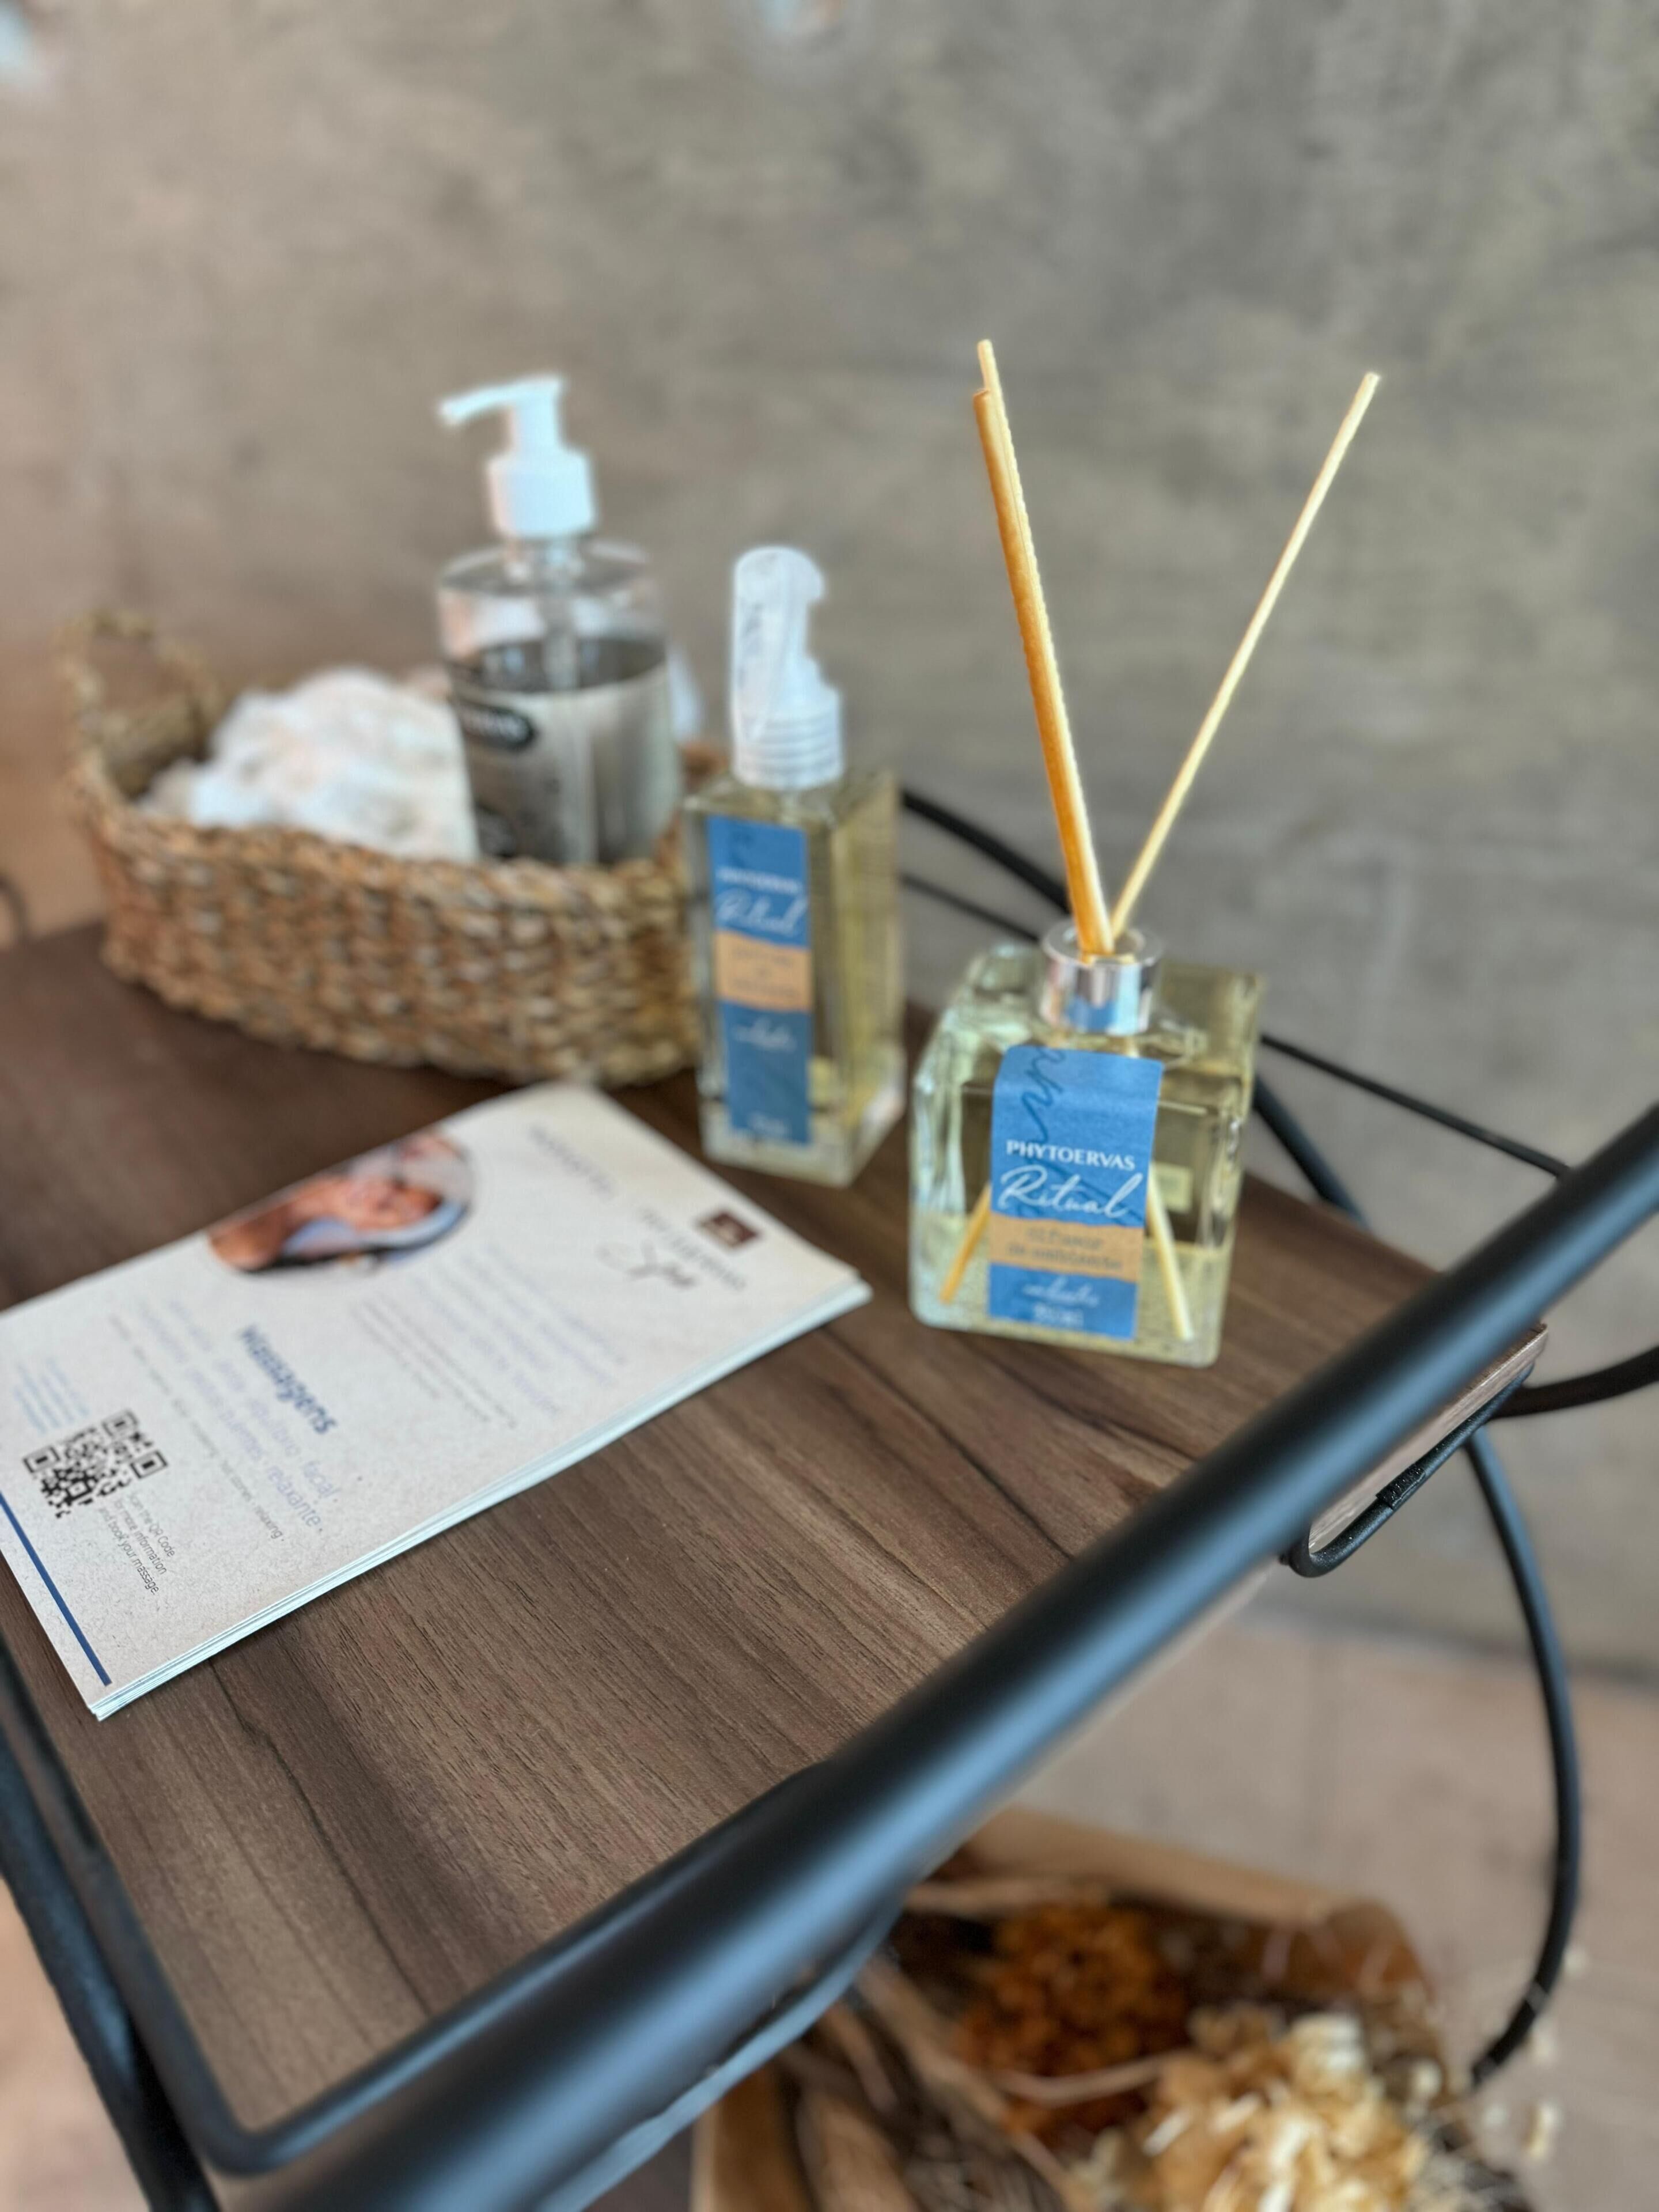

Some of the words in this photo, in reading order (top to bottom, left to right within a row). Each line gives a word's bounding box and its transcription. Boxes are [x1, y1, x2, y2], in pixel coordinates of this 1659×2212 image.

[1006, 1139, 1136, 1171] PHYTOERVAS
[997, 1164, 1144, 1218] Ritual
[266, 1464, 320, 1527] relaxante
[108, 1520, 126, 1540] book
[118, 1540, 137, 1558] your
[132, 1558, 159, 1595] massage.
[134, 1530, 167, 1574] information
[149, 1522, 164, 1537] QR
[157, 1536, 175, 1556] Code
